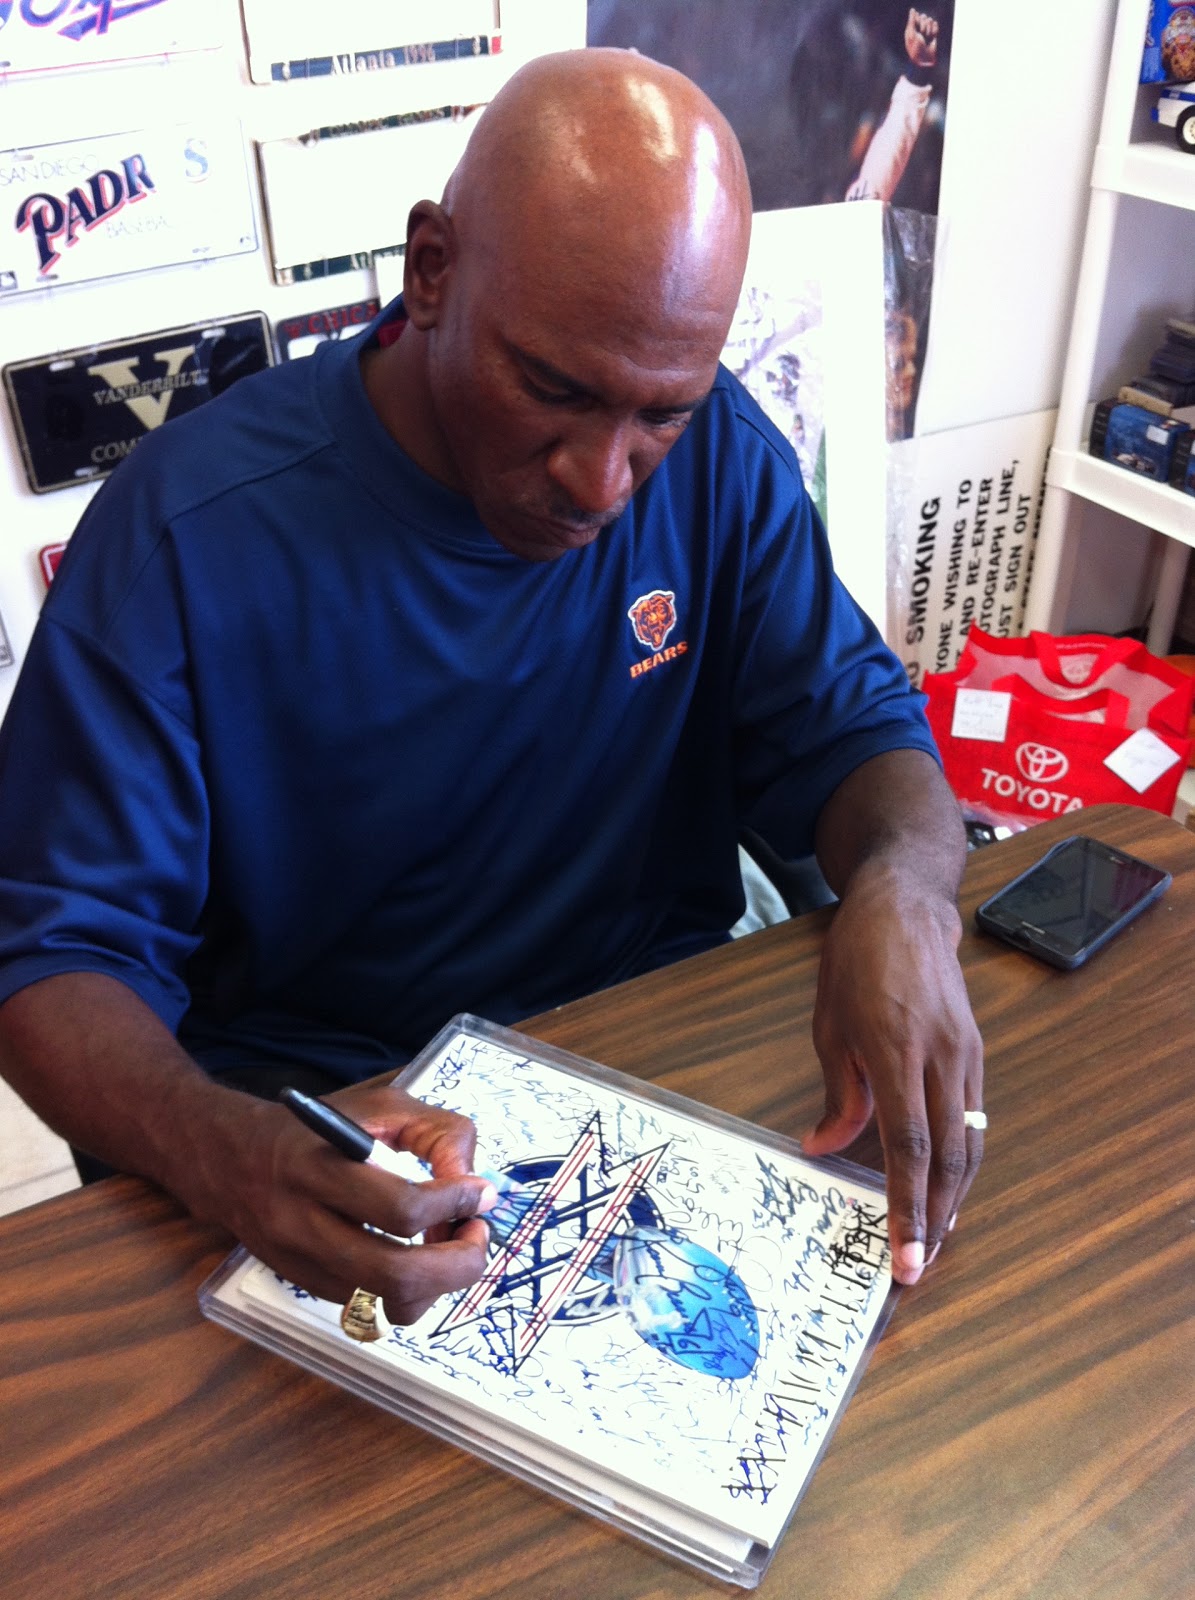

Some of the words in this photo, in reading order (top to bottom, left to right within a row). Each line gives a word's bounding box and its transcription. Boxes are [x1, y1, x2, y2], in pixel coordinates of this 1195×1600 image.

[93, 370, 207, 406] VANDERBILT
[996, 459, 1020, 515] LINE,
[943, 518, 967, 610] WISHING
[956, 479, 972, 510] TO
[966, 477, 993, 587] RE-ENTER
[1005, 545, 1022, 592] SIGN
[1014, 493, 1031, 534] OUT
[906, 497, 941, 645] SMOKING
[959, 596, 976, 636] AND
[629, 641, 688, 679] BEARS
[980, 767, 1084, 815] TOYOTA
